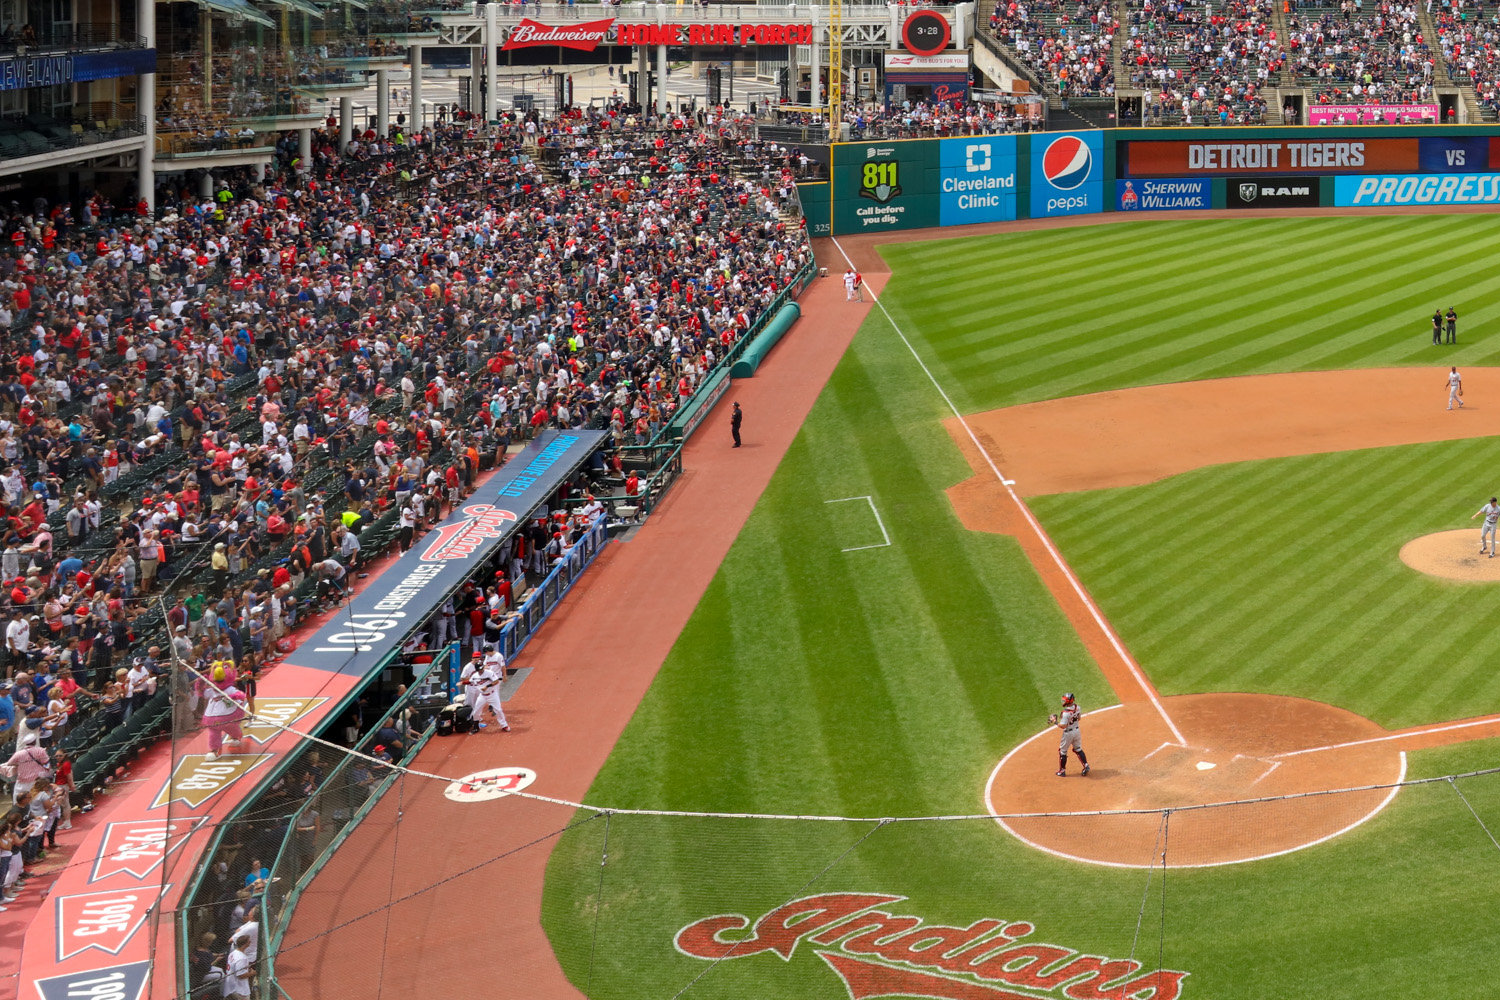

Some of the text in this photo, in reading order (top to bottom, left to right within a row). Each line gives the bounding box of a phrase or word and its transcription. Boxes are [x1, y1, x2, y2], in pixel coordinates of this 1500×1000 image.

[510, 24, 604, 42] Budweiser
[617, 24, 813, 45] HOME RUN PORCH
[917, 26, 938, 35] 3:28
[1189, 143, 1365, 168] DETROIT TIGERS
[1446, 150, 1465, 165] VS
[863, 162, 897, 188] 811
[943, 173, 1014, 192] Cleveland
[1143, 181, 1202, 194] SHERWIN
[1261, 187, 1309, 196] RAM
[958, 192, 1000, 209] Clinic
[1047, 194, 1087, 212] pepsi
[1142, 195, 1202, 208] WILLIAMS
[856, 205, 904, 216] Call before
[814, 223, 830, 232] 325
[863, 214, 898, 226] you dig.
[498, 434, 579, 498] PROGRESSIVE FIELD
[435, 504, 517, 561] Indians
[314, 563, 446, 652] ESTABLISHED 1901
[176, 760, 242, 790] 1948
[111, 824, 176, 862] 1954
[72, 895, 138, 937] 1995
[673, 891, 1190, 1000] Indians
